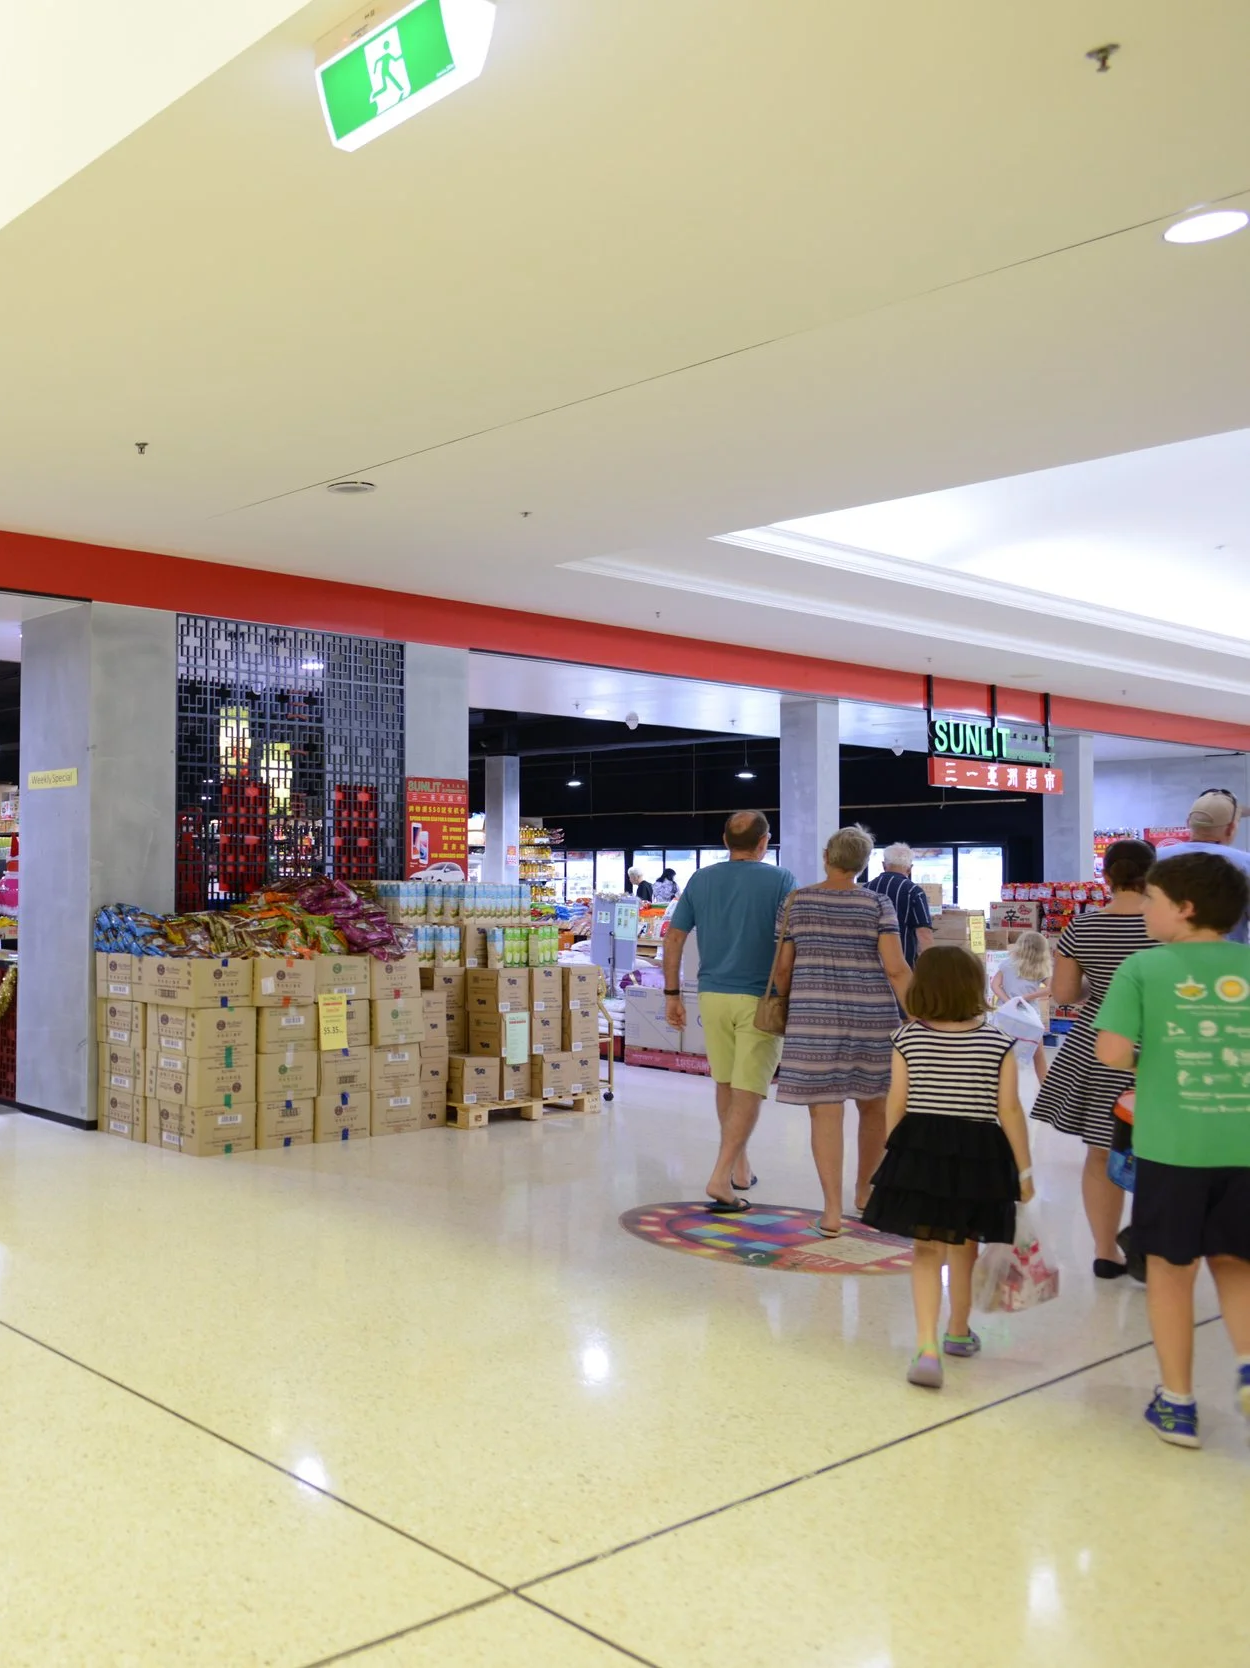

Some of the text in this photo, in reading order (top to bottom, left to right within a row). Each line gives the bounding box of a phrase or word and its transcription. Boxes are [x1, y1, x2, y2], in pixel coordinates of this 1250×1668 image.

[934, 719, 1010, 758] SUNLIT
[31, 771, 72, 785] Weekly Special
[408, 781, 441, 793] SUNLIT
